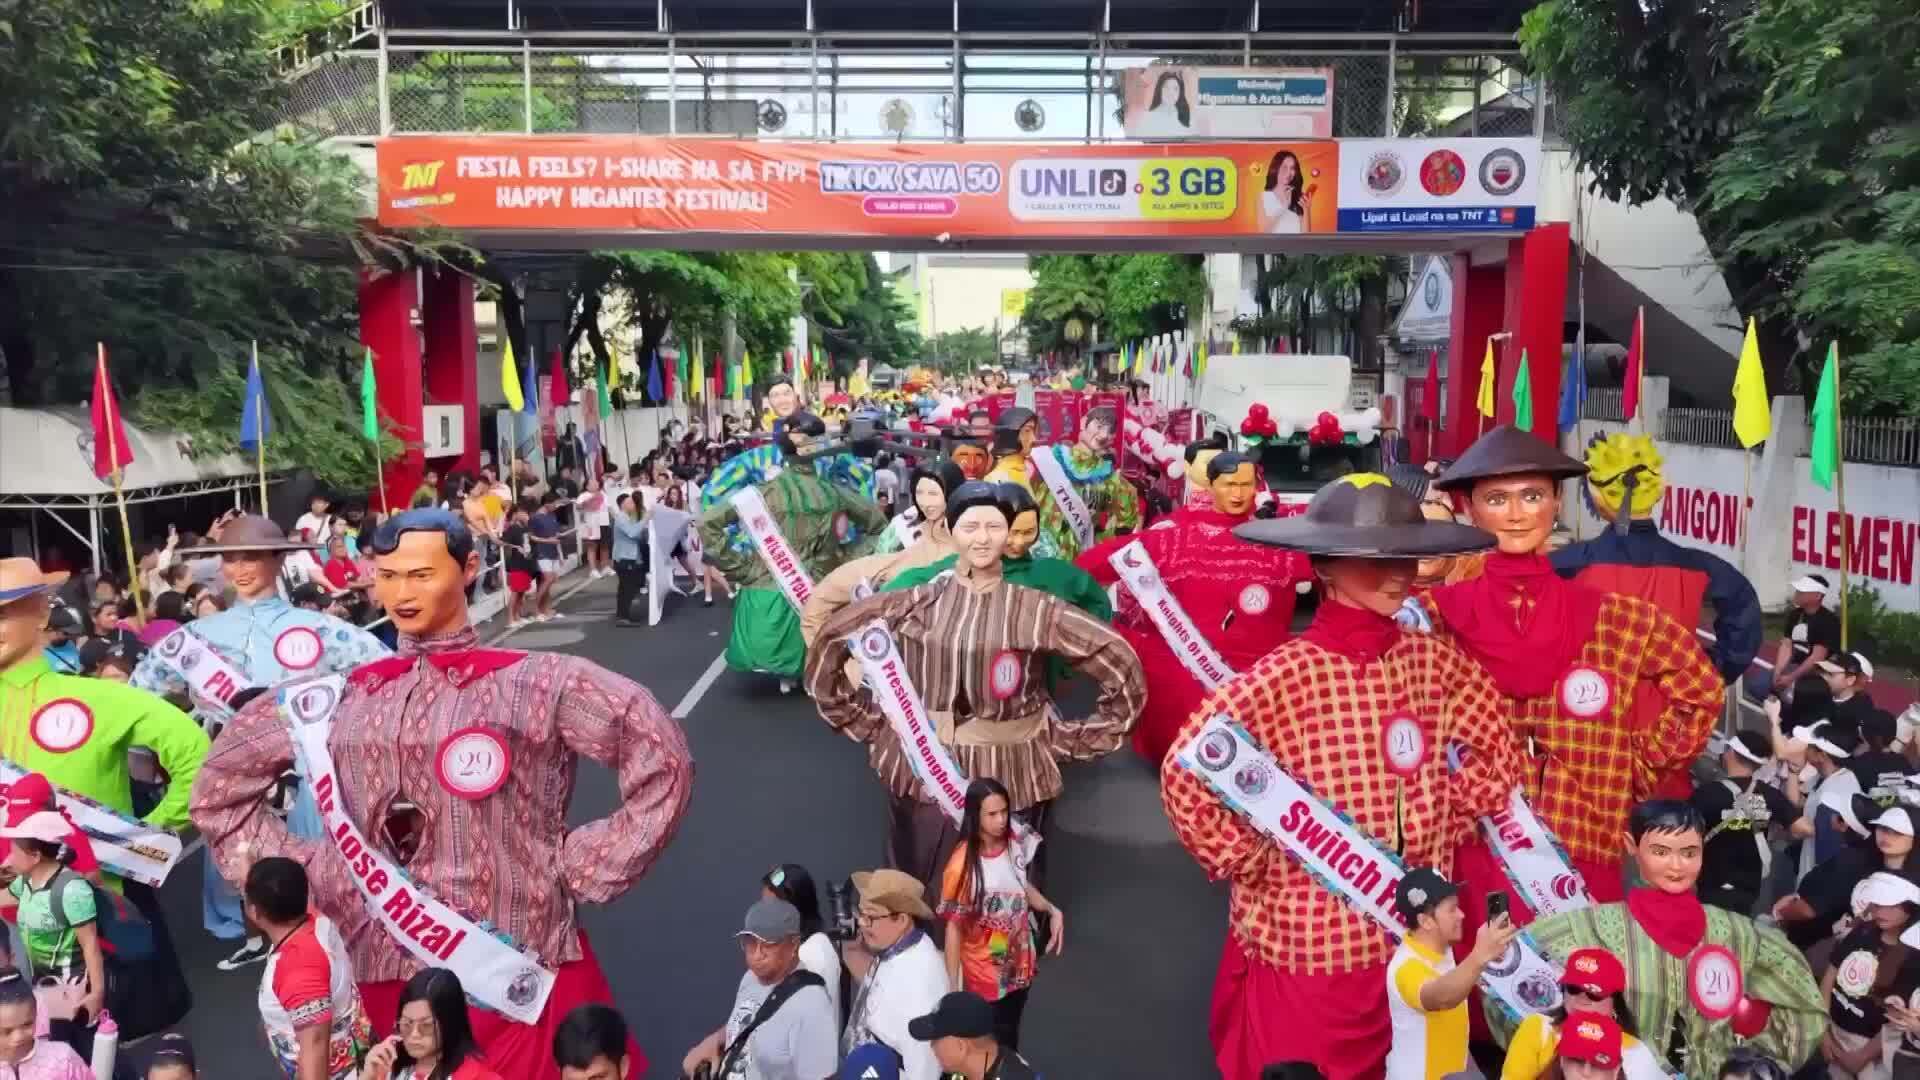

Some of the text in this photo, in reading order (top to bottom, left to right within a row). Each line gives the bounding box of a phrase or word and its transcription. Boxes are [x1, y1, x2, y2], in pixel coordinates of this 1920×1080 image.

[402, 160, 445, 190] TNT
[456, 156, 522, 178] FIESTA
[528, 156, 598, 178] FEELS?
[604, 158, 684, 179] I-SHARE
[691, 160, 721, 180] NA
[727, 160, 755, 180] SA
[820, 162, 1001, 193] TIKTOK SAYA 50
[1151, 168, 1226, 196] 3 GB
[1021, 169, 1097, 197] UNLI
[496, 186, 769, 212] HAPPY HIGANTES FESTIVAL!
[1361, 211, 1388, 223] Lipat
[1402, 211, 1429, 222] Load
[1462, 210, 1484, 220] TNT
[1792, 505, 1920, 586] ELEMEN
[1157, 598, 1191, 644] Knights
[1196, 654, 1225, 682] Rizal
[1573, 680, 1601, 704] 22
[882, 659, 966, 811] President Bongbong
[1393, 728, 1415, 757] 21
[458, 750, 494, 778] 29
[1279, 799, 1383, 897] Switch
[382, 886, 468, 971] Rizal
[1704, 966, 1731, 996] 20
